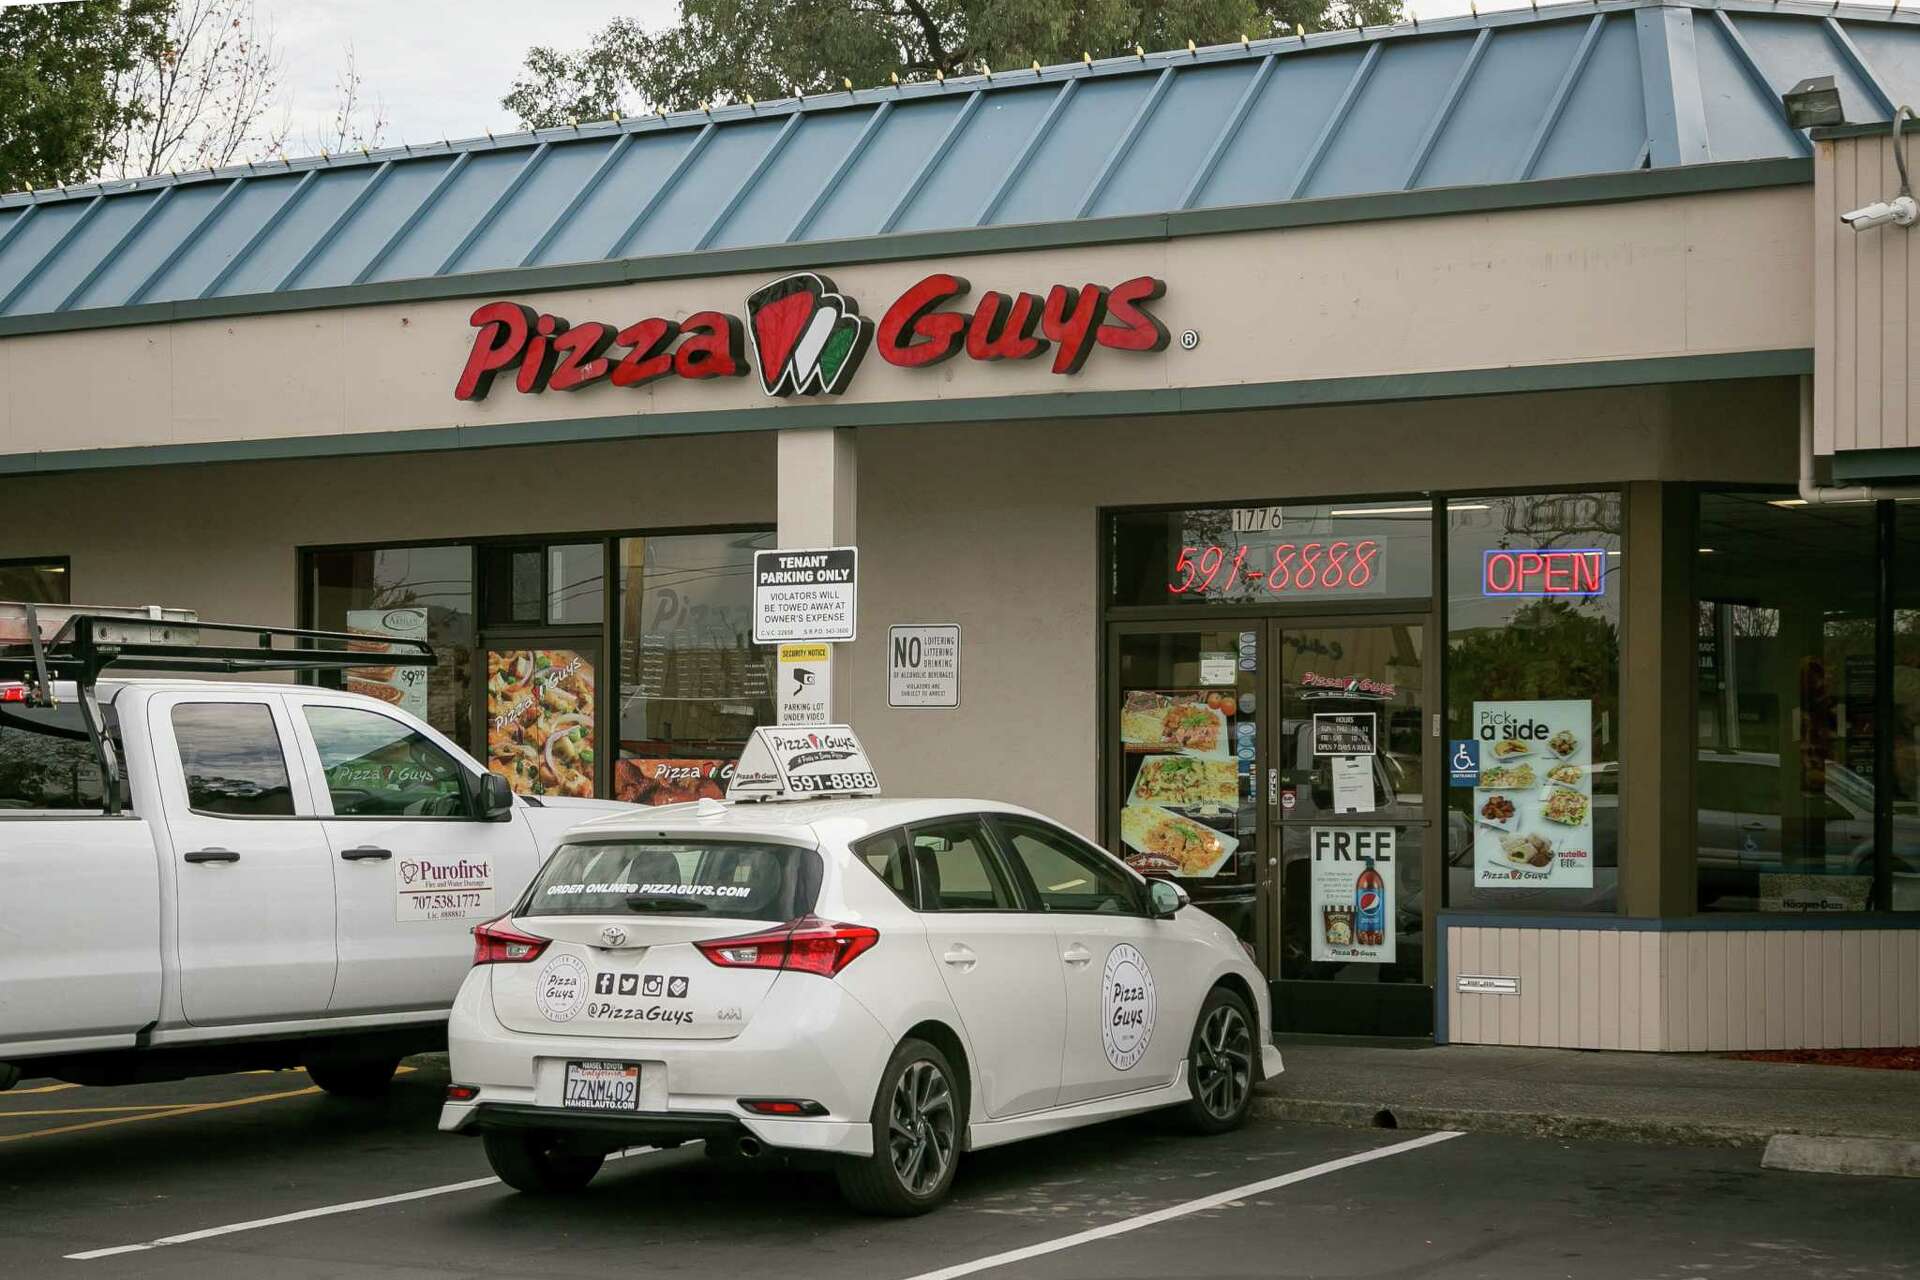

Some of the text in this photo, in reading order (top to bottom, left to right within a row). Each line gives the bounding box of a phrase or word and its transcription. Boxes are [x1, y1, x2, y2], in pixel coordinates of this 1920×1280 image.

[455, 300, 750, 400] Pizza
[877, 273, 1170, 375] Guys
[1236, 509, 1281, 530] 1776
[779, 555, 828, 568] TENANT
[1169, 540, 1377, 593] 591-8888
[760, 569, 850, 584] PARKING ONLY
[1487, 553, 1600, 592] OPEN
[770, 591, 839, 601] VIOLATORS WILL
[764, 604, 775, 612] BE
[778, 603, 808, 612] TOWED
[810, 602, 833, 611] AWAY
[764, 613, 845, 623] OWNER'S EXPENSE
[924, 637, 955, 645] LOITERING
[782, 648, 826, 658] SECURITY NOTICE
[894, 637, 921, 668] NO
[923, 647, 953, 656] LITTERING
[923, 659, 952, 668] DRINKING
[495, 695, 534, 733] Pizza
[548, 657, 582, 689] Guys
[784, 703, 824, 711] PARKING LOT
[783, 712, 825, 721] UNDER VIDEO
[1480, 710, 1512, 725] Pick
[1480, 719, 1550, 740] a side
[773, 735, 855, 751] Pizza Guys
[339, 766, 434, 782] Pizza Guys
[654, 763, 701, 779] Pizza
[790, 773, 877, 791] 591-8888
[1315, 831, 1391, 862] FREE
[1558, 850, 1587, 858] nutella
[420, 860, 489, 880] Purofirst
[1482, 871, 1549, 880] Pizza Guys
[547, 885, 583, 895] ORDER
[639, 884, 750, 898] PIZZAGUYS.COM
[412, 893, 481, 909] 707.538.1772
[548, 975, 577, 986] Pizza
[546, 987, 574, 999] Guys
[1113, 982, 1144, 1003] Pizza
[588, 1002, 694, 1025] @PizzaGuys
[1112, 1006, 1143, 1028] Guys
[570, 1078, 634, 1101] 7ZNM409
[565, 1100, 635, 1110] HANSELAUTO.COM
